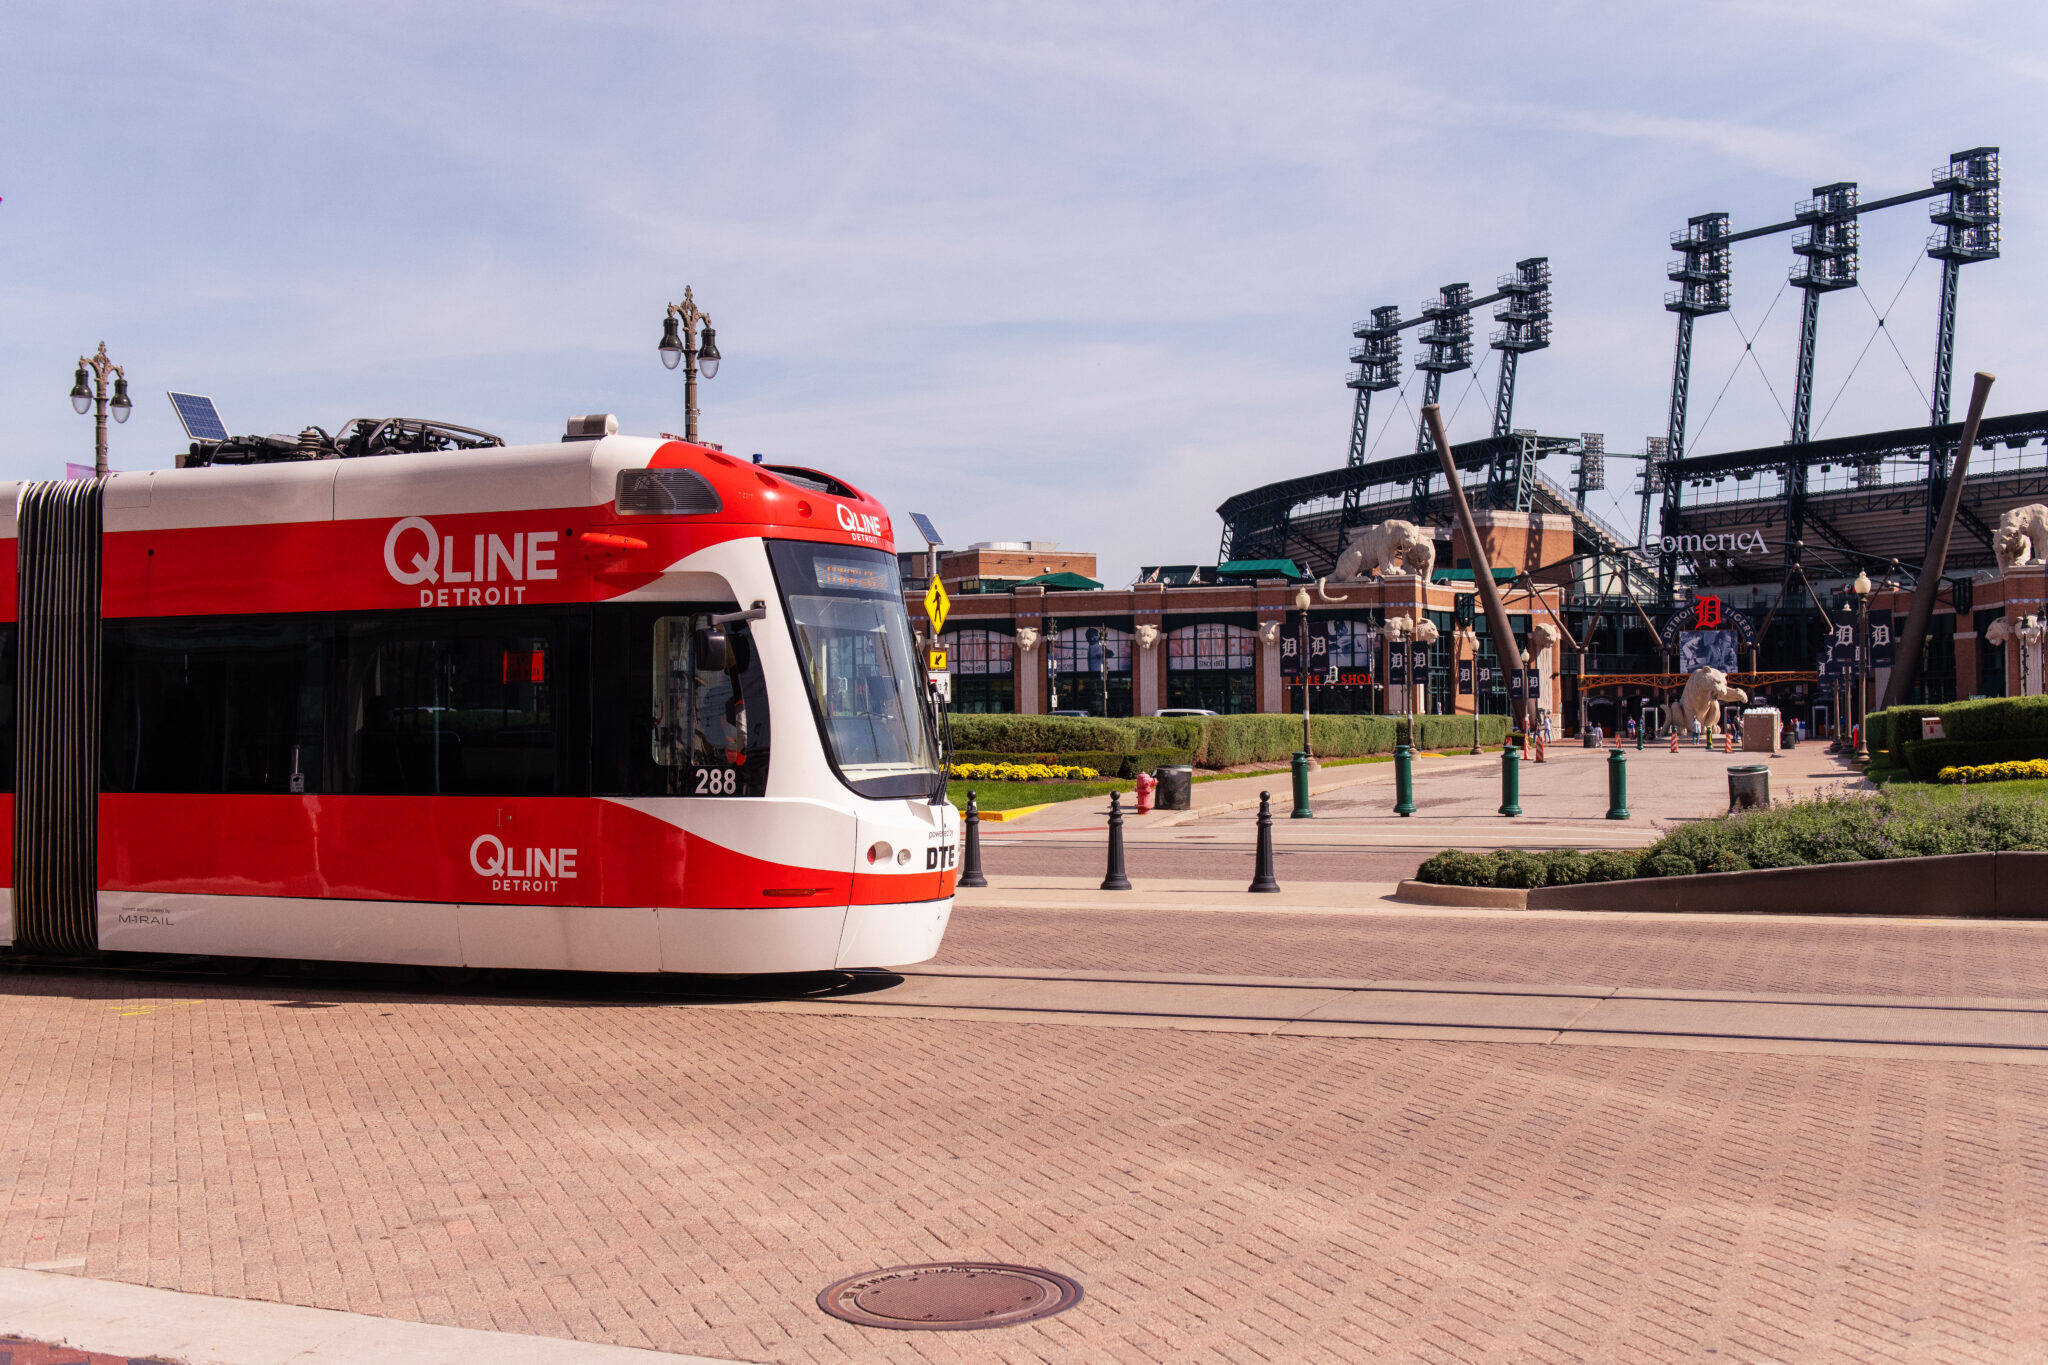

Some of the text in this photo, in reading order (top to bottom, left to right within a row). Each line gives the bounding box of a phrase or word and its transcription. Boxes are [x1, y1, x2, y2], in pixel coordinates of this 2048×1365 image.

[836, 503, 882, 537] QLINE
[383, 516, 559, 586] QLINE
[851, 532, 878, 545] DETROIT
[1676, 558, 1735, 569] PARK
[420, 586, 527, 608] DETROIT
[1664, 606, 1754, 639] DETROIT TIGERS
[1693, 593, 1722, 631] D
[947, 637, 1008, 665] UMMER
[1175, 632, 1249, 661] SUMMER
[695, 768, 737, 795] 288
[469, 833, 578, 879] QLINE
[926, 844, 955, 870] DTE
[491, 879, 559, 893] DETROIT
